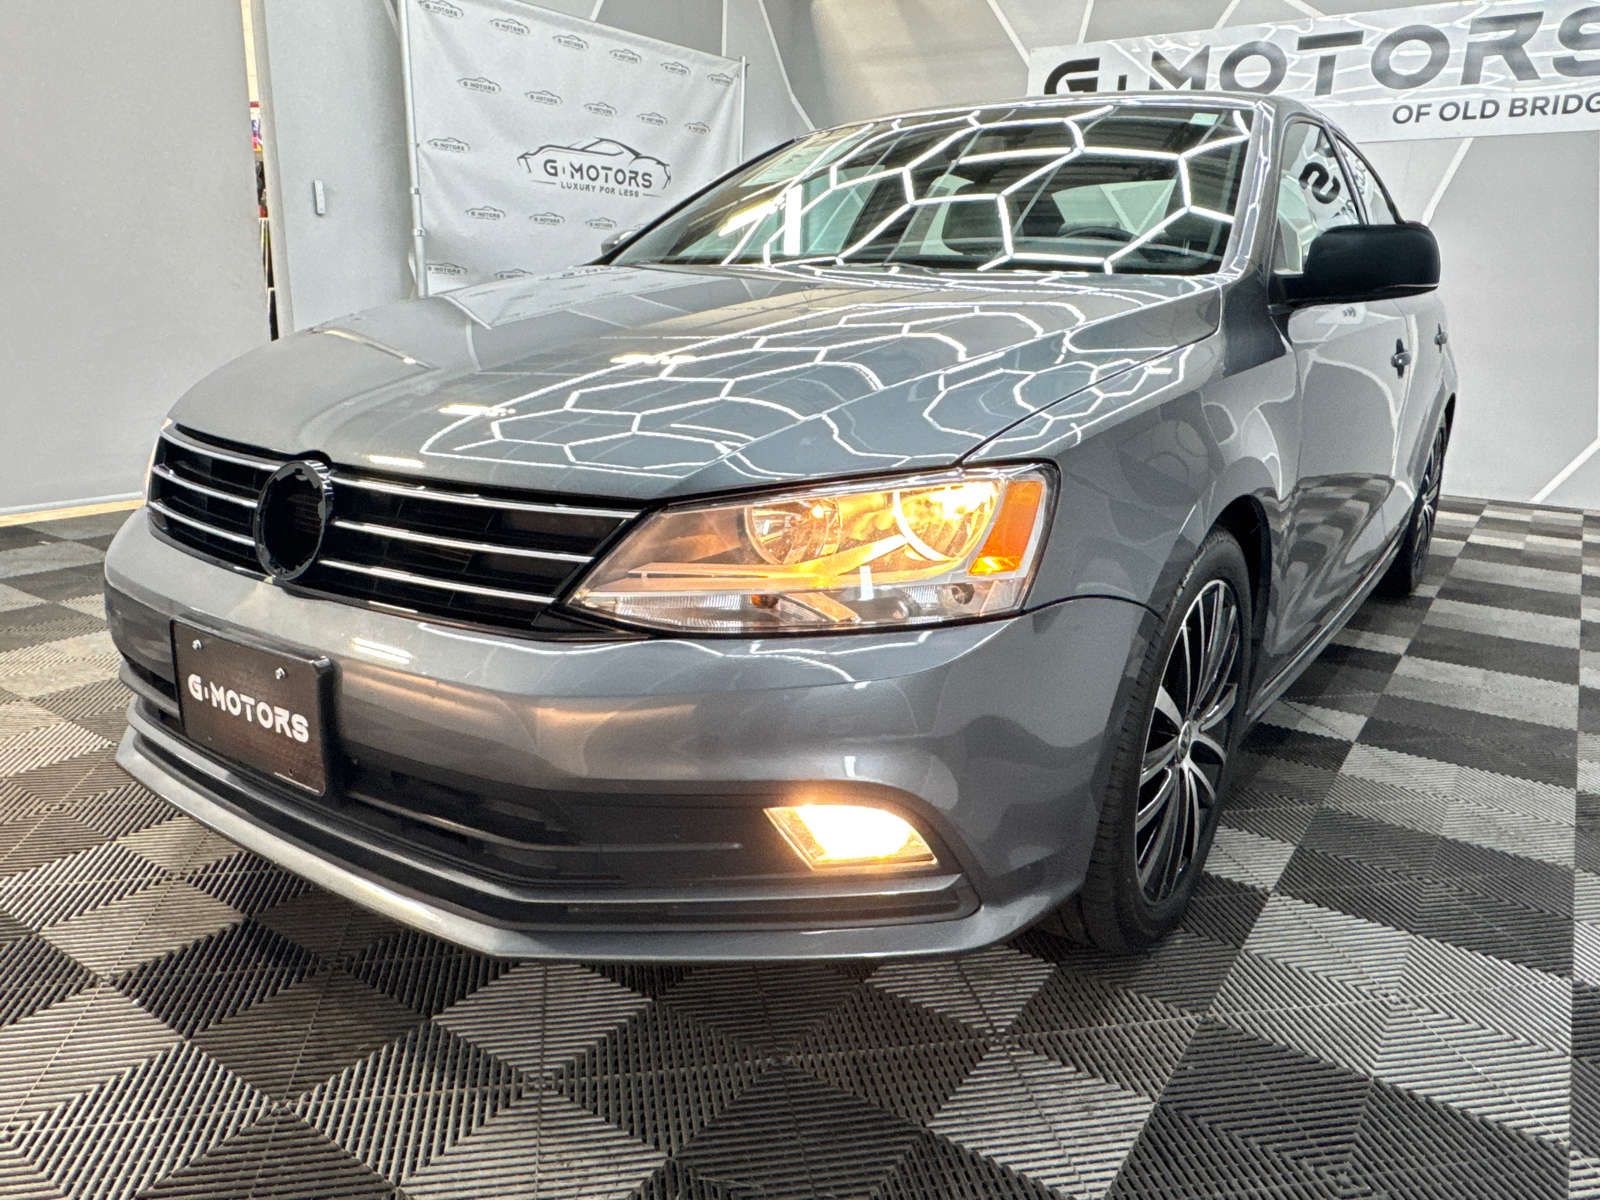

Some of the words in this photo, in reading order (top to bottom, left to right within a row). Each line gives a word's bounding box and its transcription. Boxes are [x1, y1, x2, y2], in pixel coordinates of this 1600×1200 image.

[1392, 104, 1431, 124] OF
[1439, 99, 1500, 121] OLD
[561, 181, 596, 193] LUXURY
[599, 186, 616, 195] FOR
[619, 189, 640, 198] LESS
